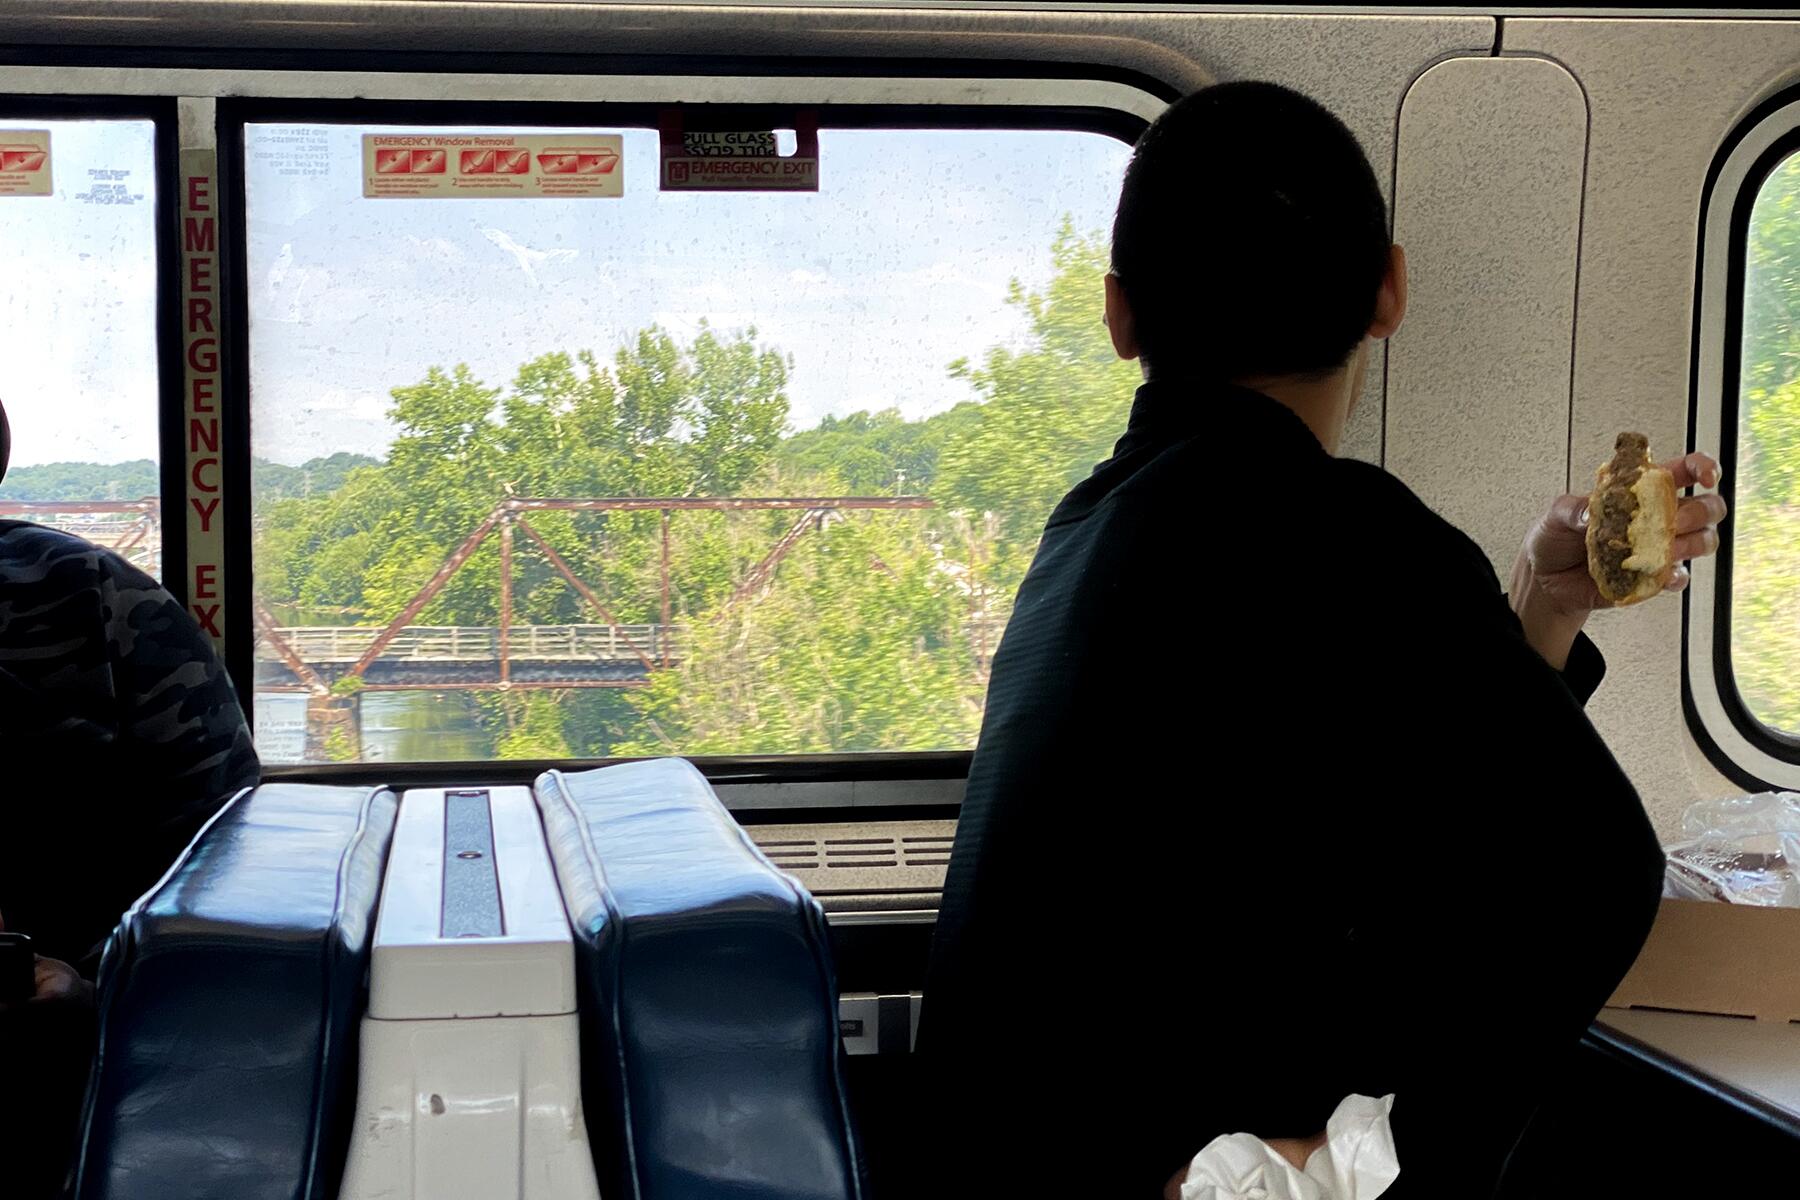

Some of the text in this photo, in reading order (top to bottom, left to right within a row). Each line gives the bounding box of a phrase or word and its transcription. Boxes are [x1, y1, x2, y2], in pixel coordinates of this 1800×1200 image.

[374, 137, 514, 146] EMERGENCY Window Removal
[683, 133, 775, 144] PULL GLASS
[691, 161, 816, 174] EMERGENCY EXIT
[452, 177, 458, 186] 2
[535, 176, 541, 186] 3
[185, 177, 219, 532] EMERGENCY
